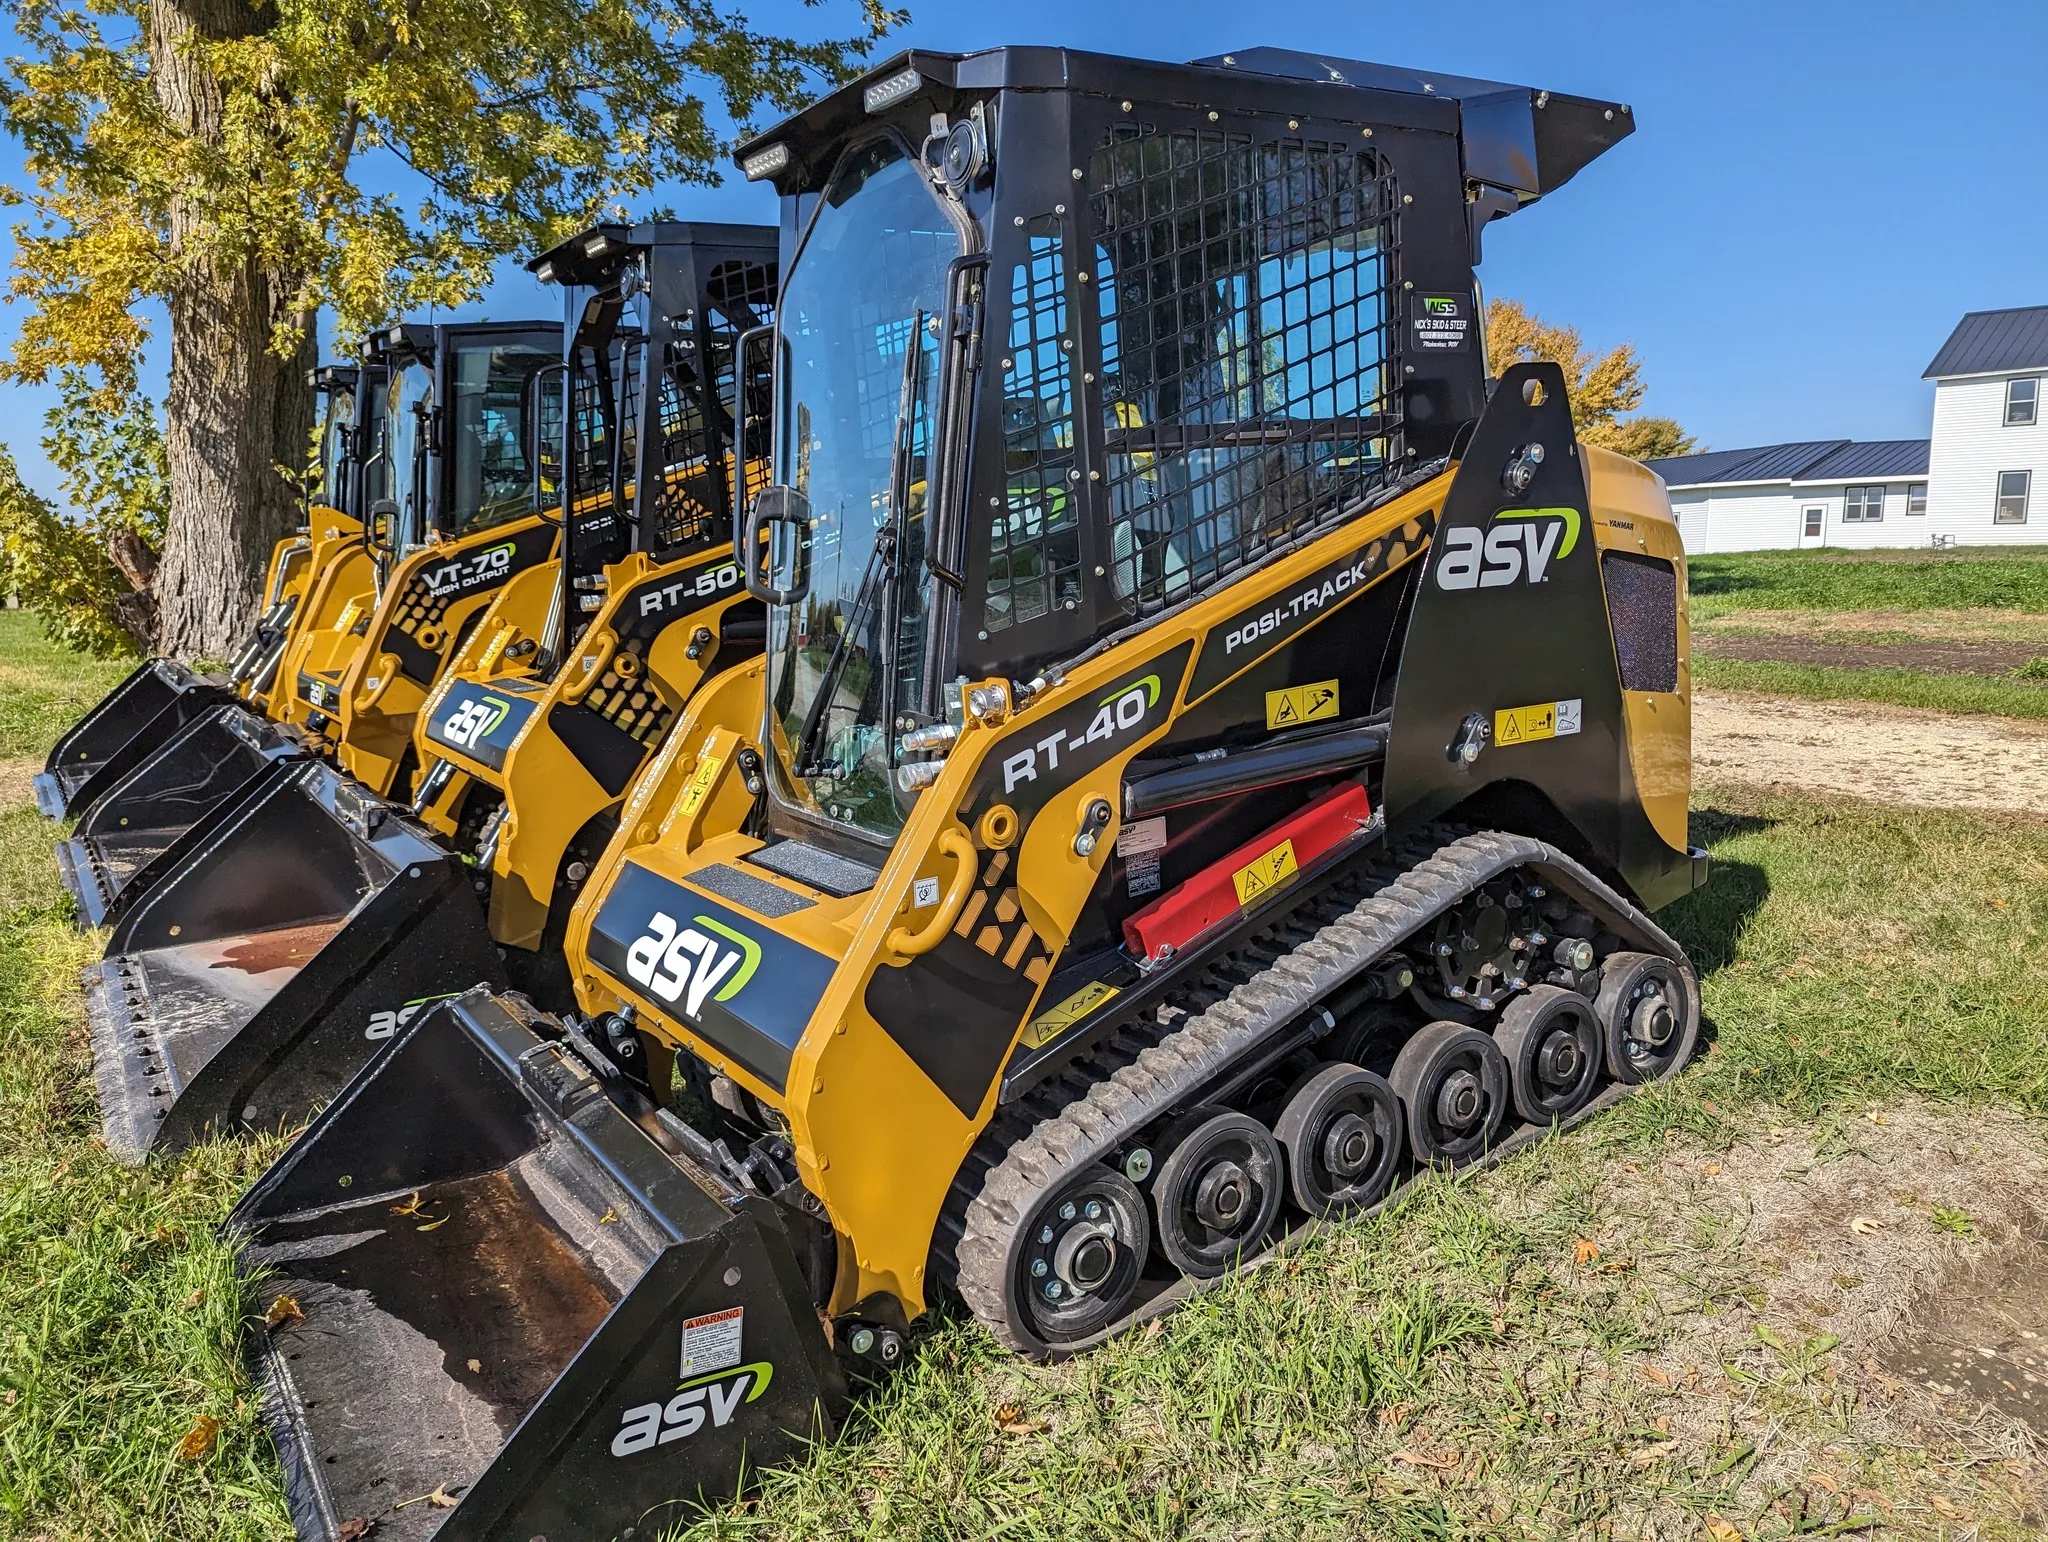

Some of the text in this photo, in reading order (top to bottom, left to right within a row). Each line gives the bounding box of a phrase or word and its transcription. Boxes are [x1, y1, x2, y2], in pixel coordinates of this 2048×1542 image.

[1450, 320, 1467, 330] STEER
[1609, 519, 1634, 530] YANMAR
[421, 548, 510, 589] VT-70
[430, 565, 510, 598] HIGH OUTPUT
[1437, 521, 1562, 591] asv
[639, 565, 738, 617] RT-50
[1225, 561, 1367, 655] POSI-TRACK
[444, 699, 500, 750] asv
[1002, 689, 1146, 795] RT-40
[1119, 826, 1135, 836] asv
[626, 911, 741, 1018] asv
[695, 1309, 740, 1327] WARNING
[611, 1374, 751, 1457] asv
